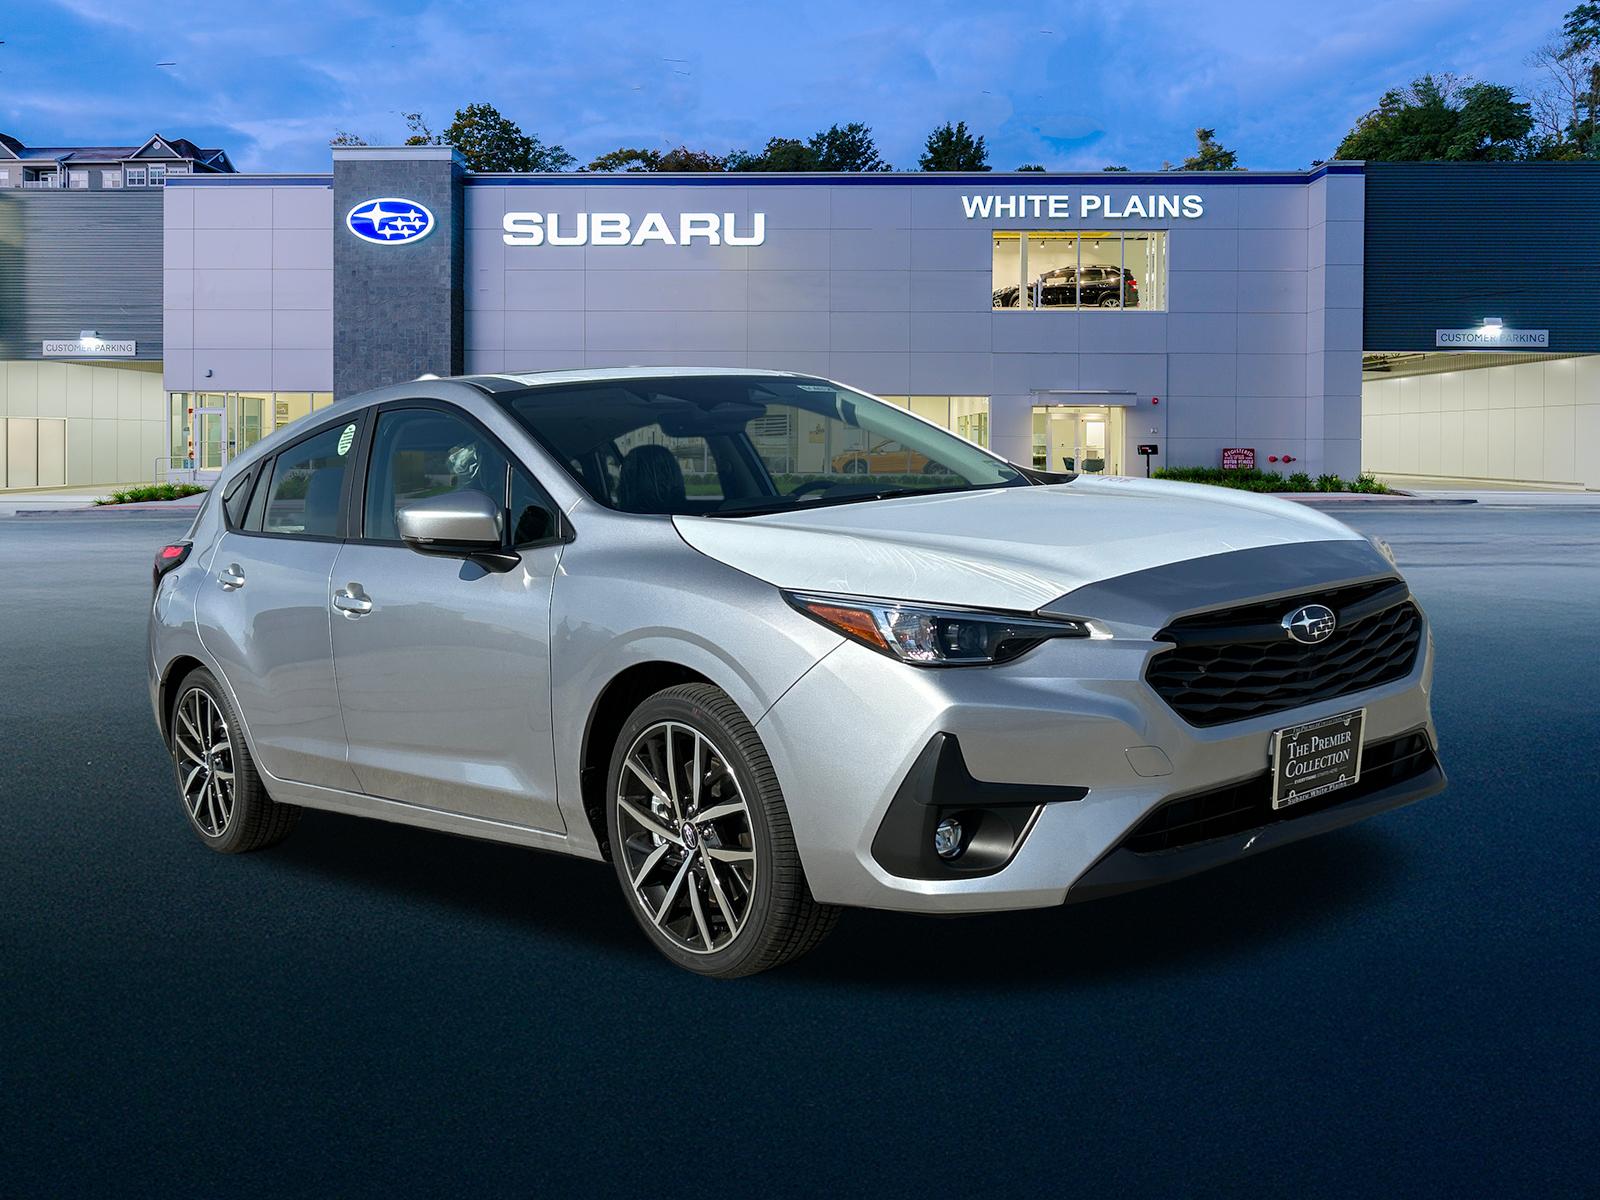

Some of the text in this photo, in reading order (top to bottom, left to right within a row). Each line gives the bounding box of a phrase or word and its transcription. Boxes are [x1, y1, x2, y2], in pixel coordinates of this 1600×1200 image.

[961, 195, 1204, 218] WHITE PLAINS
[503, 212, 765, 246] SUBARU
[46, 344, 133, 352] CUSTOMER PARKING
[1440, 333, 1545, 342] CUSTOMER PARKING
[1287, 731, 1351, 759] THE PREMIER
[1285, 749, 1350, 778] COLLECTION
[1310, 787, 1328, 799] White
[1329, 781, 1347, 793] Plains
